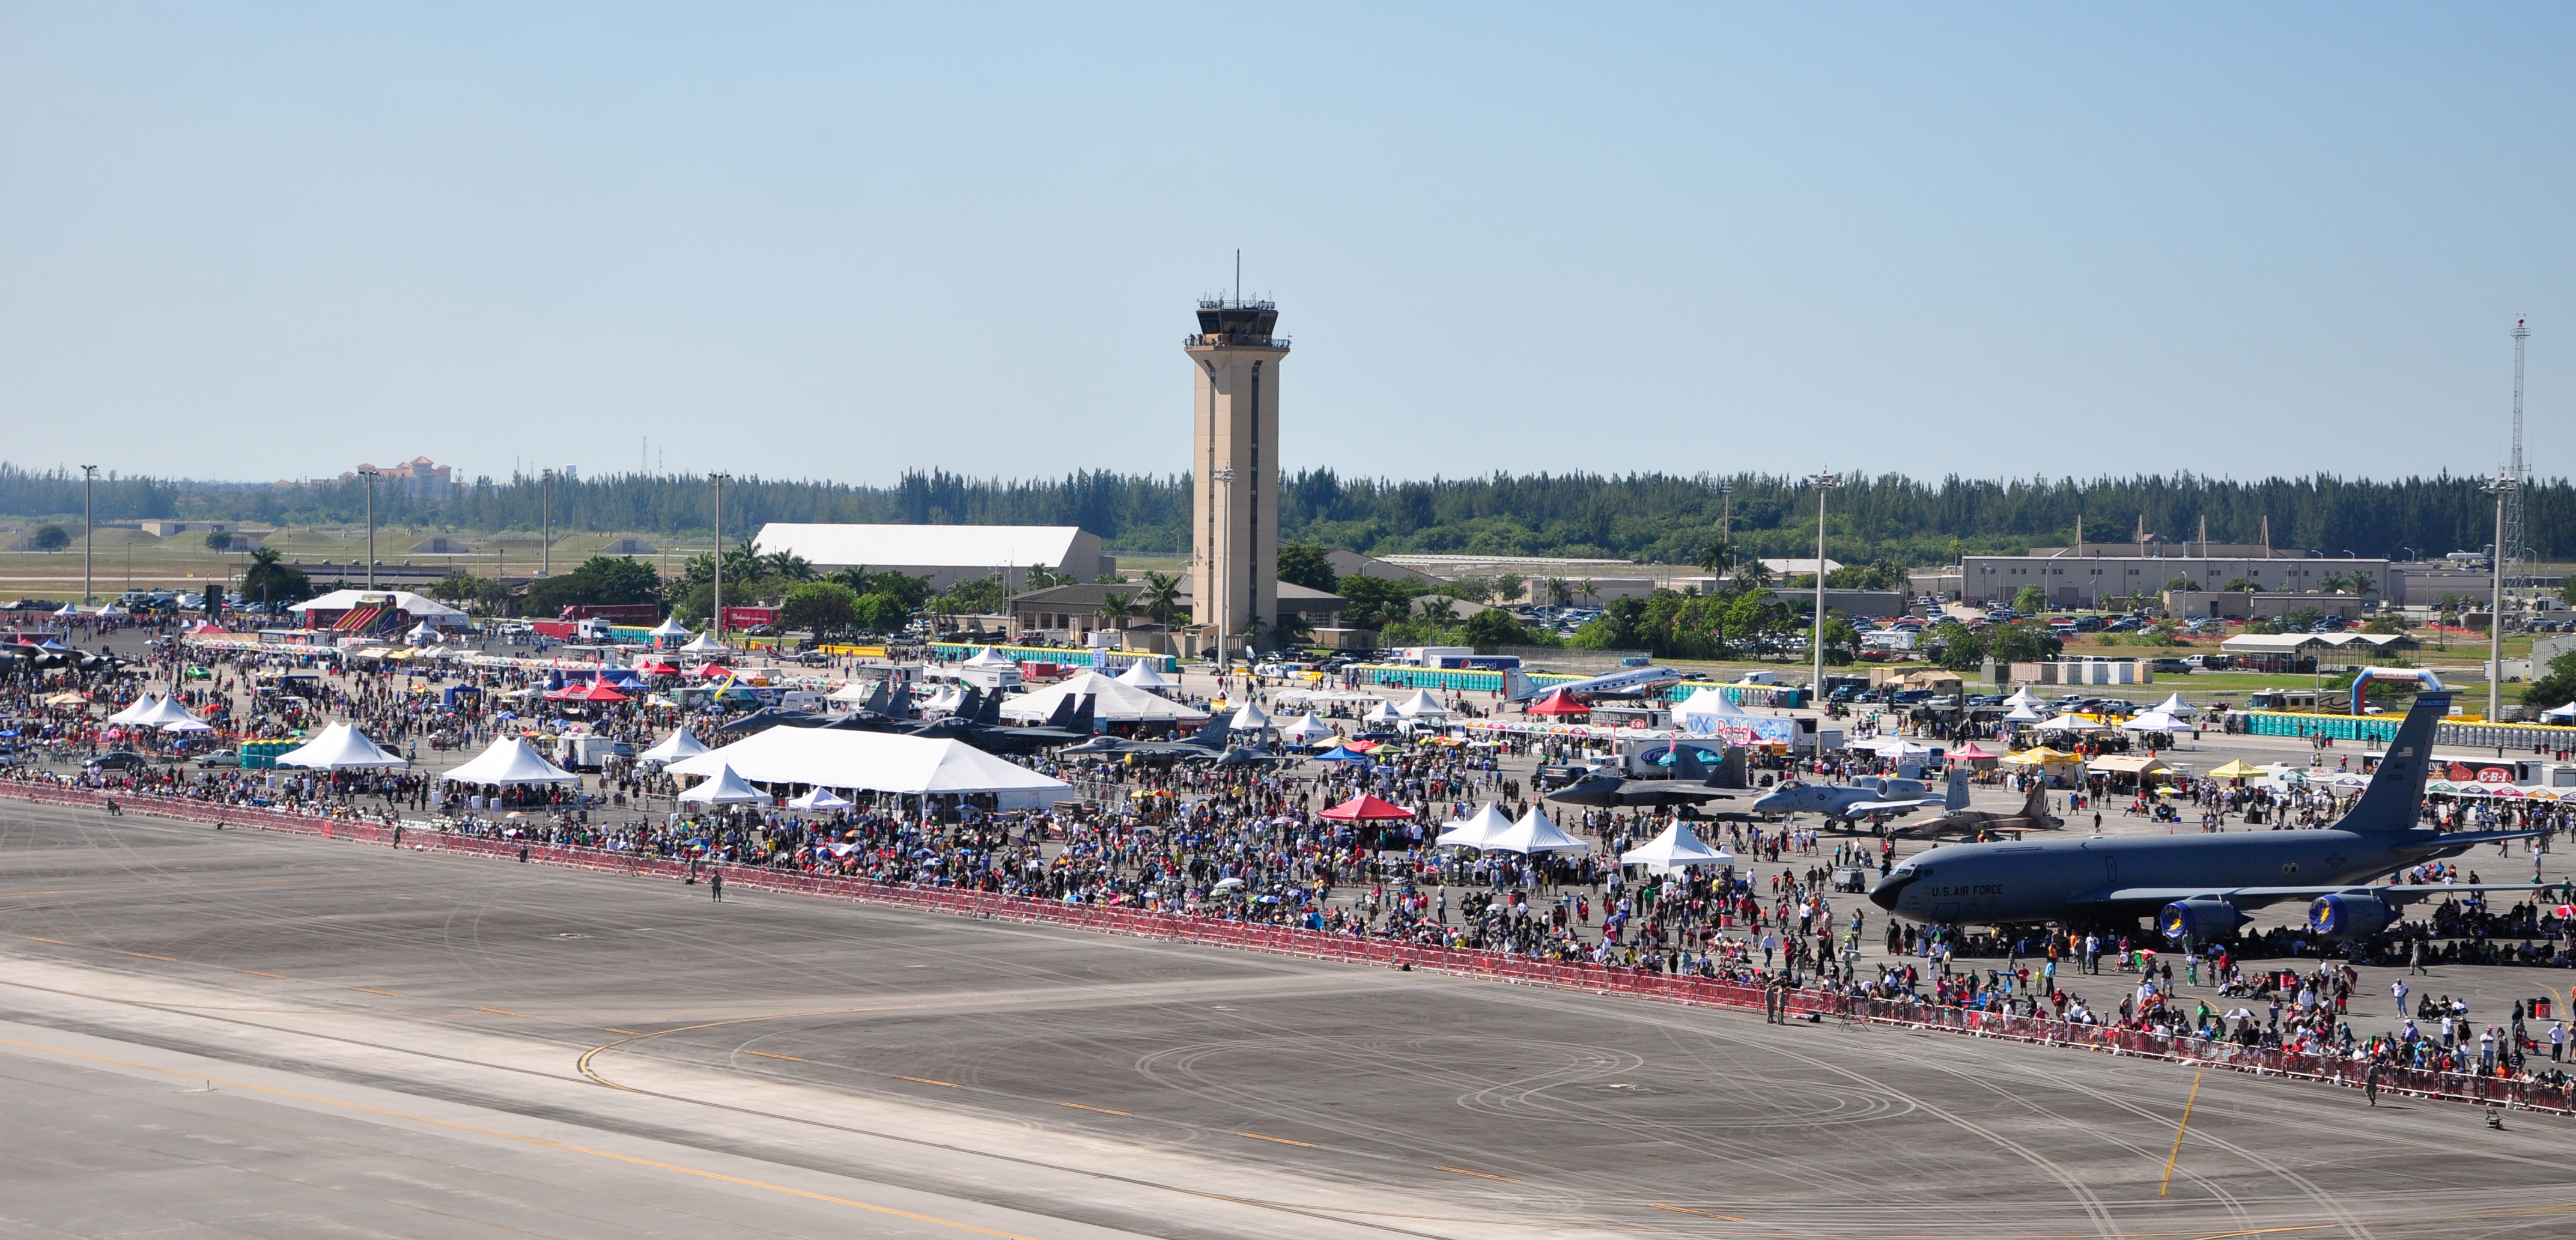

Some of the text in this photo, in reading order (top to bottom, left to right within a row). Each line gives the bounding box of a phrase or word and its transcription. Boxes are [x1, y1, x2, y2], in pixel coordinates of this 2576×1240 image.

[1718, 720, 1758, 737] Rdd
[2480, 771, 2508, 782] C-B-I
[1954, 886, 1969, 896] AIR
[1973, 884, 2003, 895] FORCE
